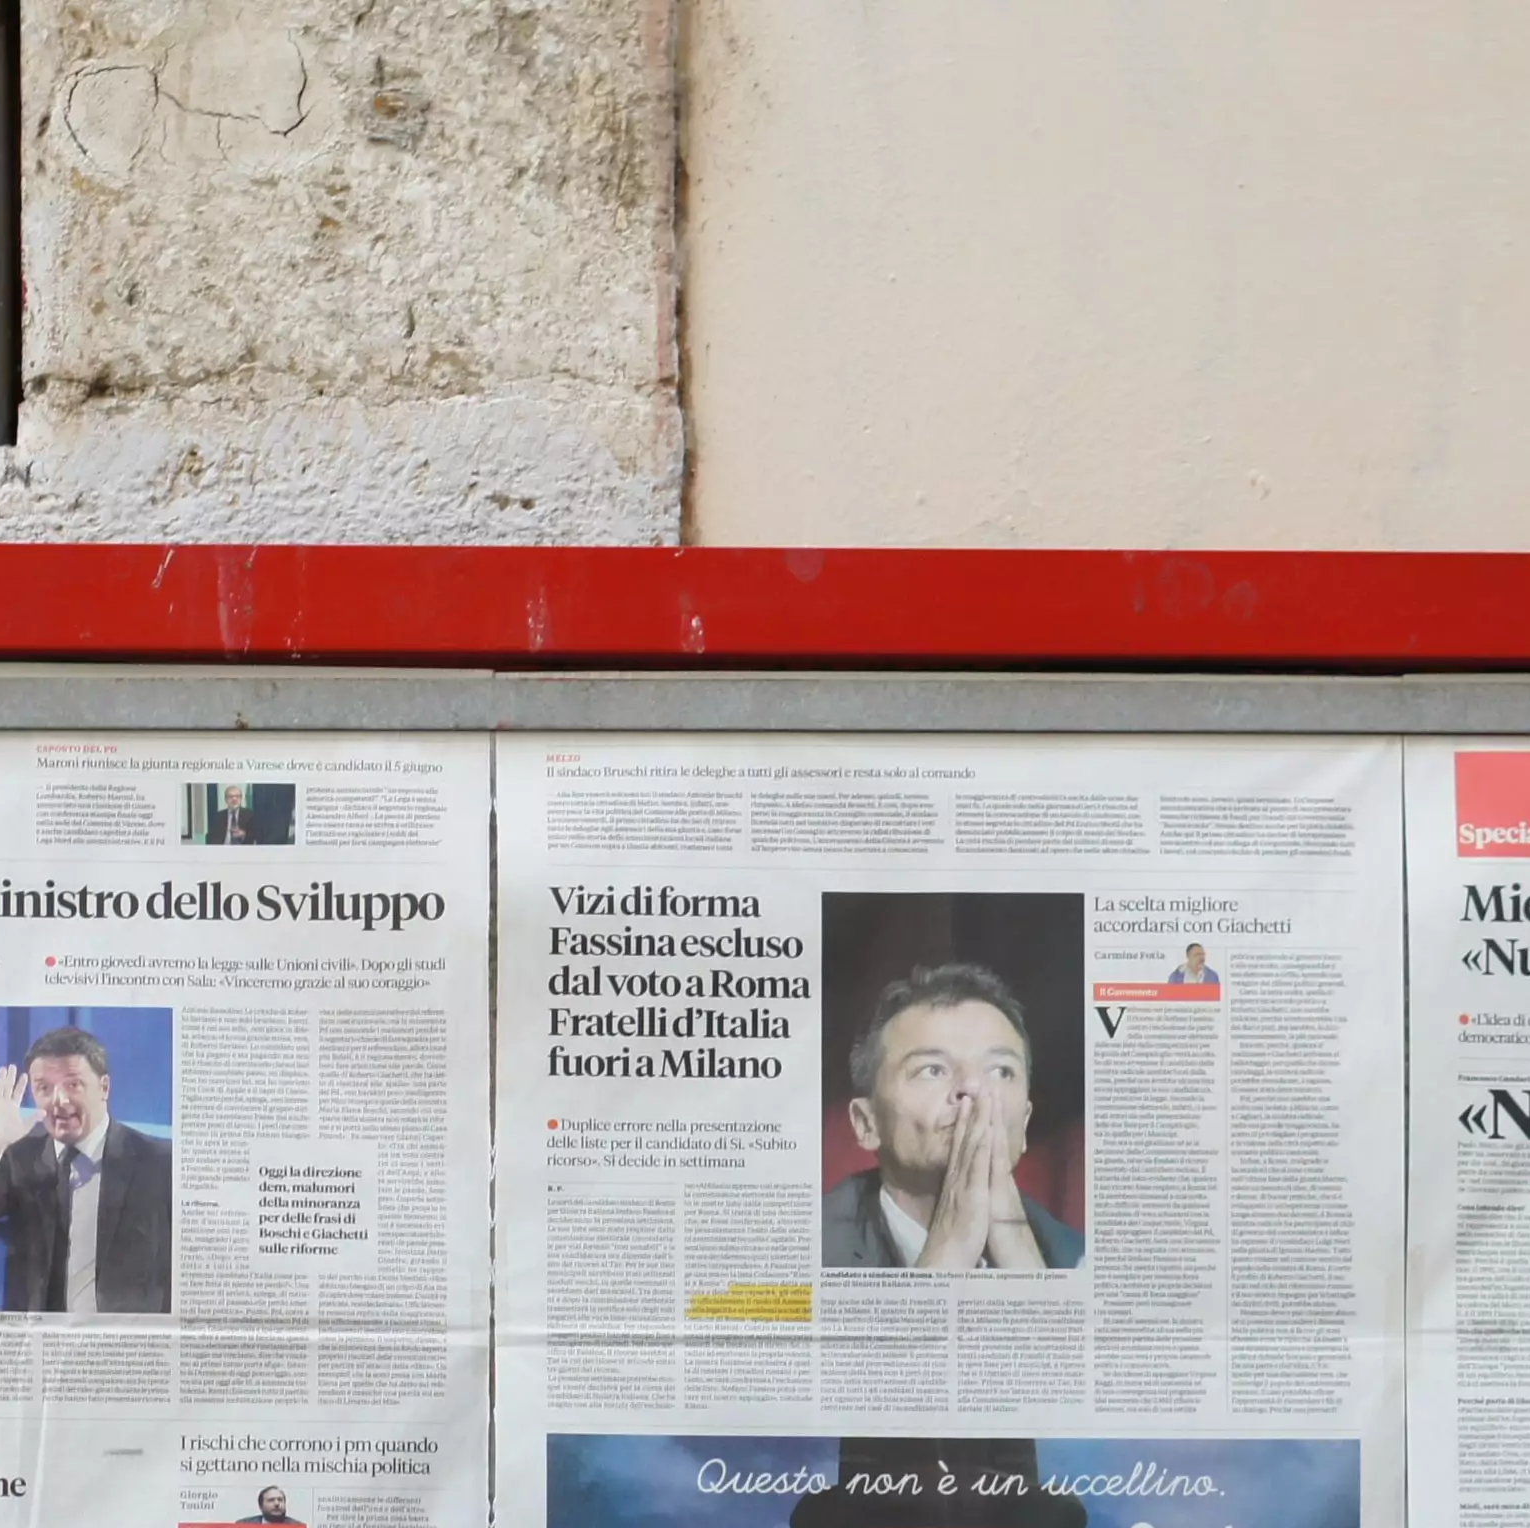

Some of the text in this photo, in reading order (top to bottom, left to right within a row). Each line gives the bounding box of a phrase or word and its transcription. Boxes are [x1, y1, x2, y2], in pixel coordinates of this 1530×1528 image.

[145, 880, 250, 921] dello
[256, 881, 445, 932] Sviluppo
[549, 885, 761, 918] Vizi di forma
[1094, 895, 1239, 915] La scelta migliore
[1093, 916, 1291, 934] accordarsi con Giachetti
[549, 925, 804, 959] Fassina escluso
[1093, 951, 1166, 960] Carmine Fotia
[548, 964, 811, 999] dal voto a Roma
[548, 1006, 668, 1038] Fratelli
[548, 1045, 782, 1079] fuori a Milano
[258, 1165, 361, 1179] Oggi la direzione
[292, 1181, 355, 1194] malumori
[258, 1196, 361, 1209] della minoranza
[259, 1212, 356, 1226] per delle frasi di
[259, 1227, 368, 1240] Boschi e Giachetti
[258, 1242, 337, 1255] sulle riforme
[181, 1435, 186, 1450] I
[190, 1434, 234, 1451] rischi
[237, 1434, 266, 1451] che
[268, 1439, 333, 1452] corrono
[344, 1440, 372, 1456] pm
[375, 1436, 439, 1457] quando
[180, 1455, 430, 1478] si gettano nella mischia politica
[696, 1458, 1226, 1497] Questo non è un uccellino.
[179, 1490, 219, 1501] Giorgio
[180, 1500, 215, 1510] Tonini
